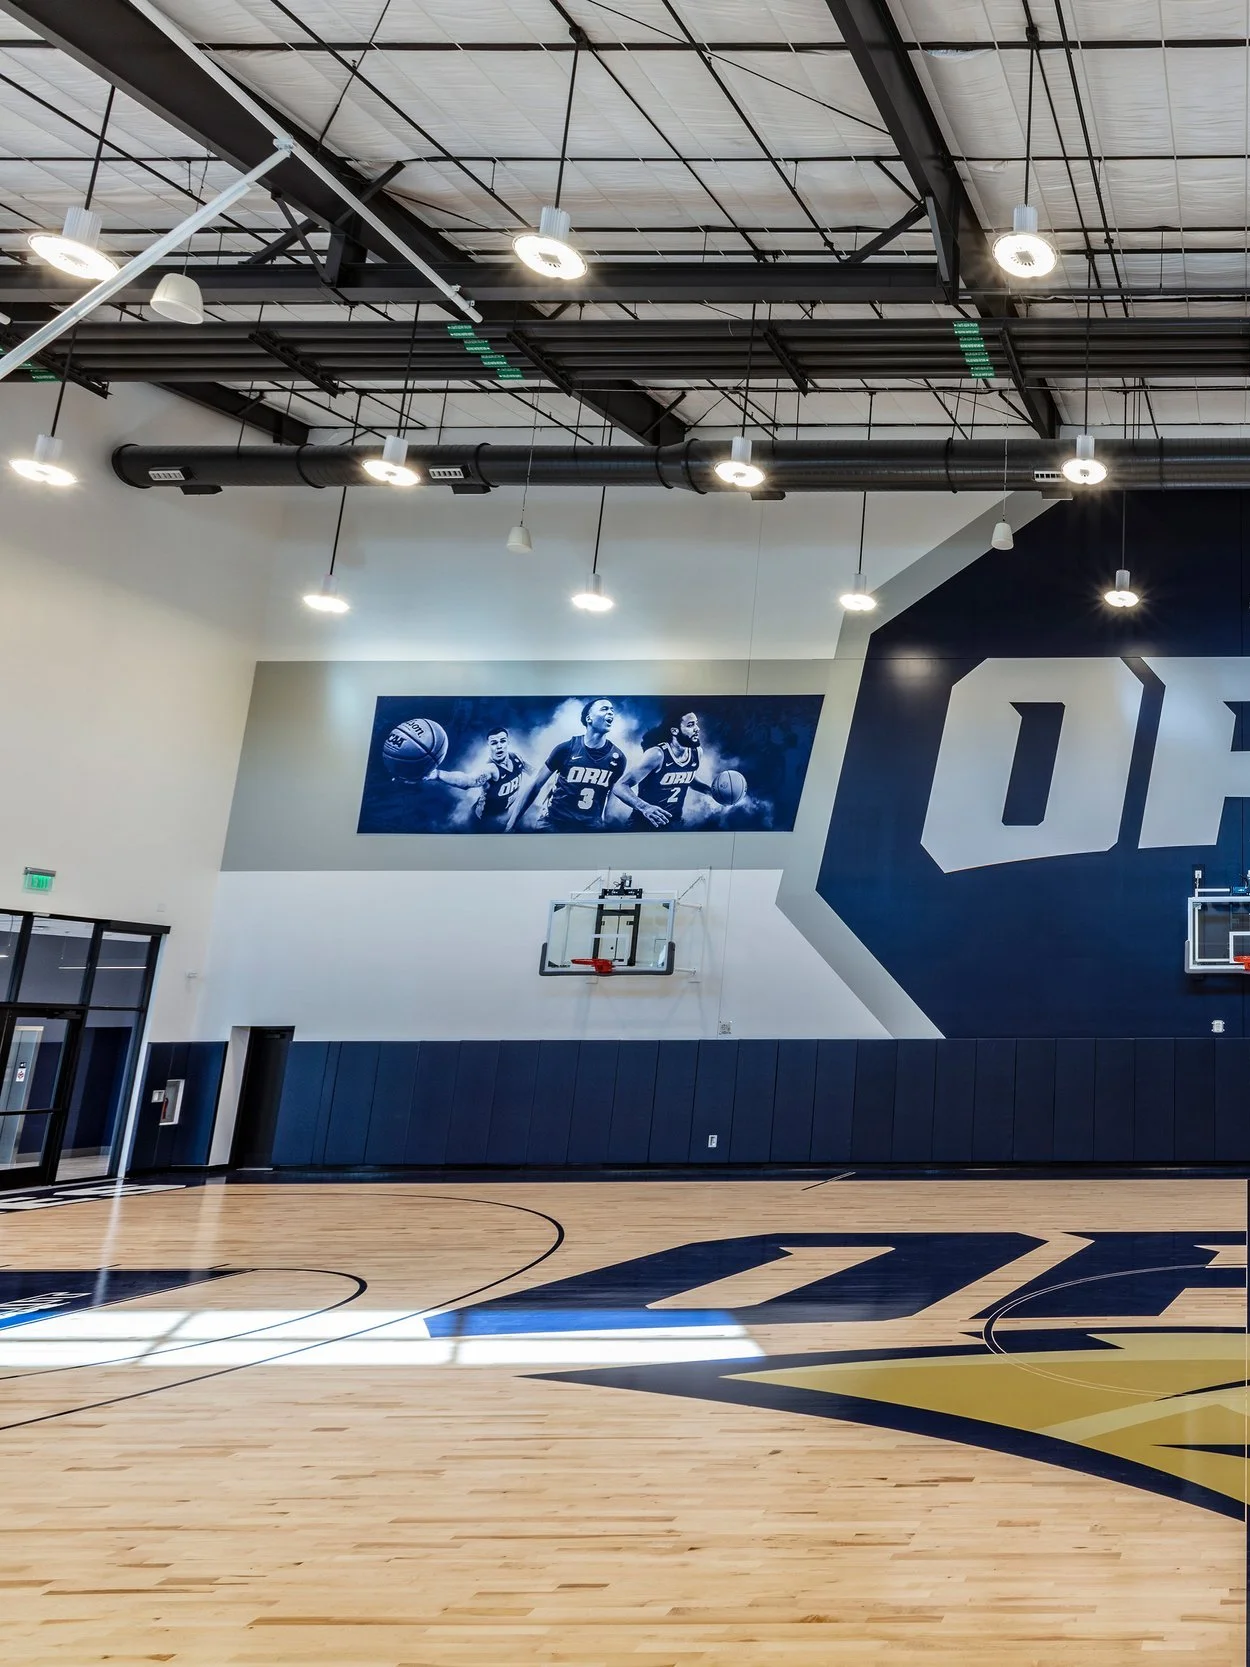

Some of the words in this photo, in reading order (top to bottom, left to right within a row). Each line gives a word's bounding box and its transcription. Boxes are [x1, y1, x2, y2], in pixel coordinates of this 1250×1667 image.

[498, 774, 521, 796] OR
[567, 766, 613, 787] ORU
[660, 771, 696, 785] ORU
[577, 788, 595, 809] 3
[667, 787, 681, 803] 2
